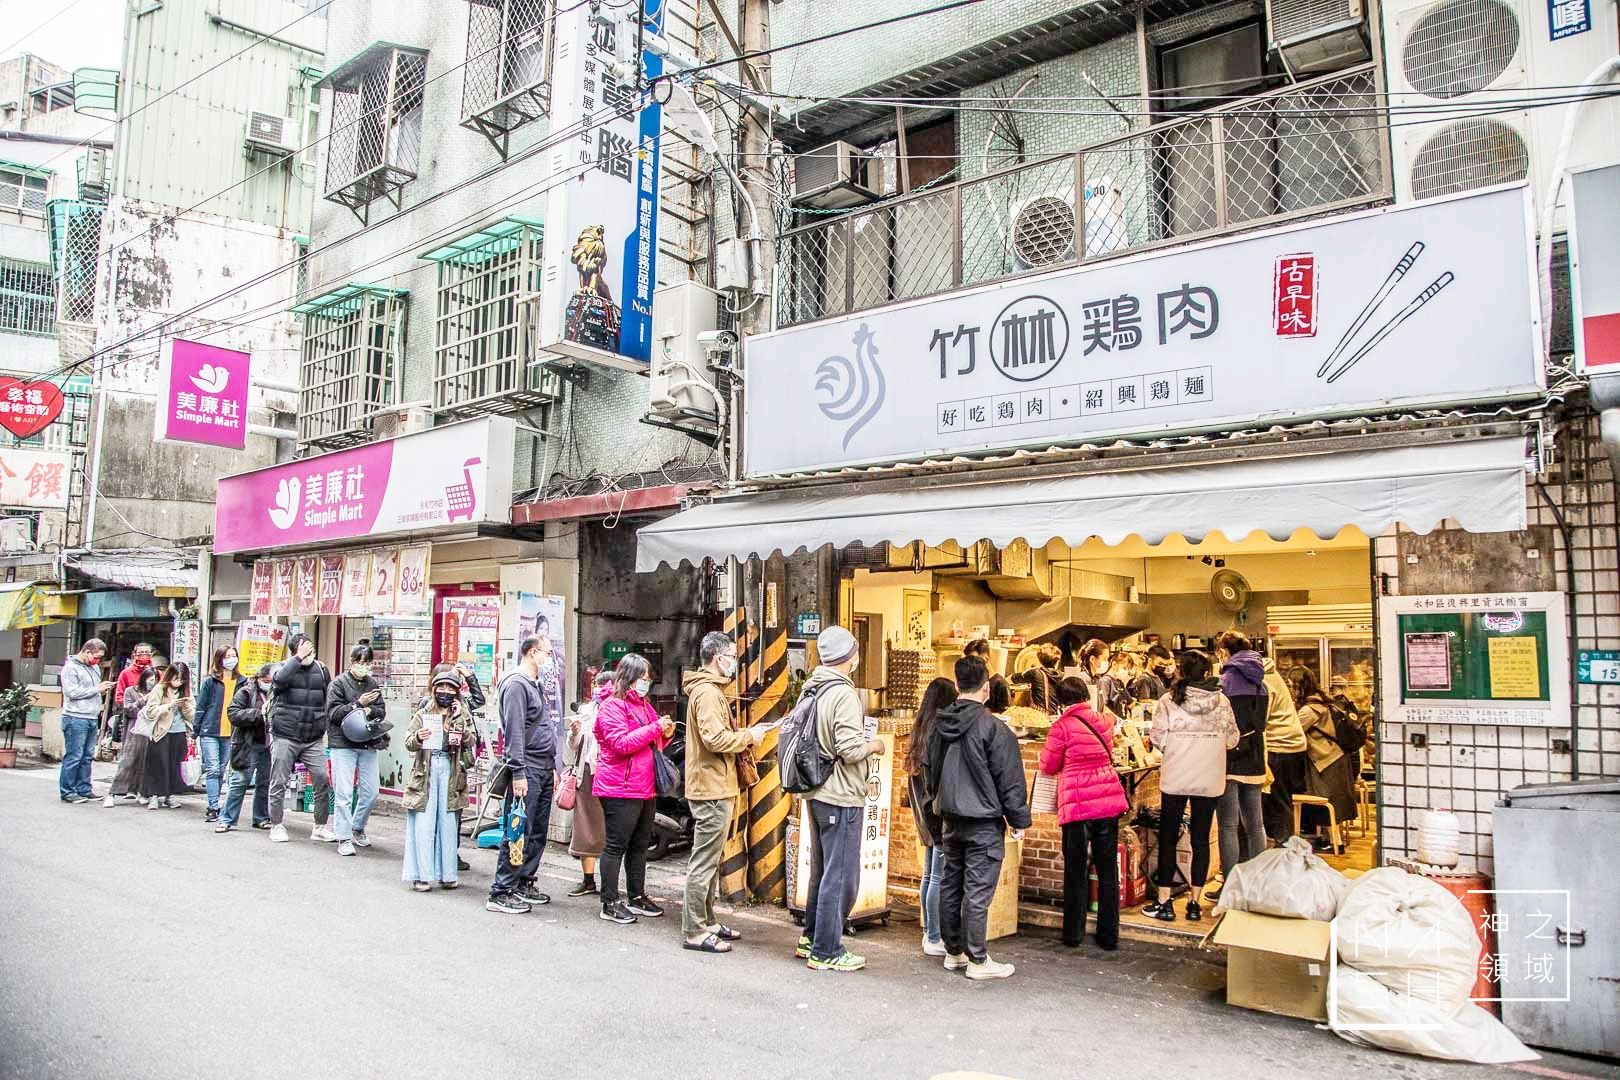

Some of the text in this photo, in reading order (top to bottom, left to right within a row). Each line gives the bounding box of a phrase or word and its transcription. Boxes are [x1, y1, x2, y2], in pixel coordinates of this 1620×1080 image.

[1553, 24, 1587, 39] MAPLE
[1280, 260, 1313, 333] 古早味
[632, 299, 652, 316] No.1
[8, 388, 43, 405] 幸福
[176, 391, 240, 419] 美廉社
[176, 410, 239, 429] Simple Mart
[305, 465, 364, 507] 美廉社
[304, 503, 363, 529] Simple Mart
[303, 572, 313, 598] 送
[322, 579, 337, 599] 20
[1602, 668, 1618, 680] 15
